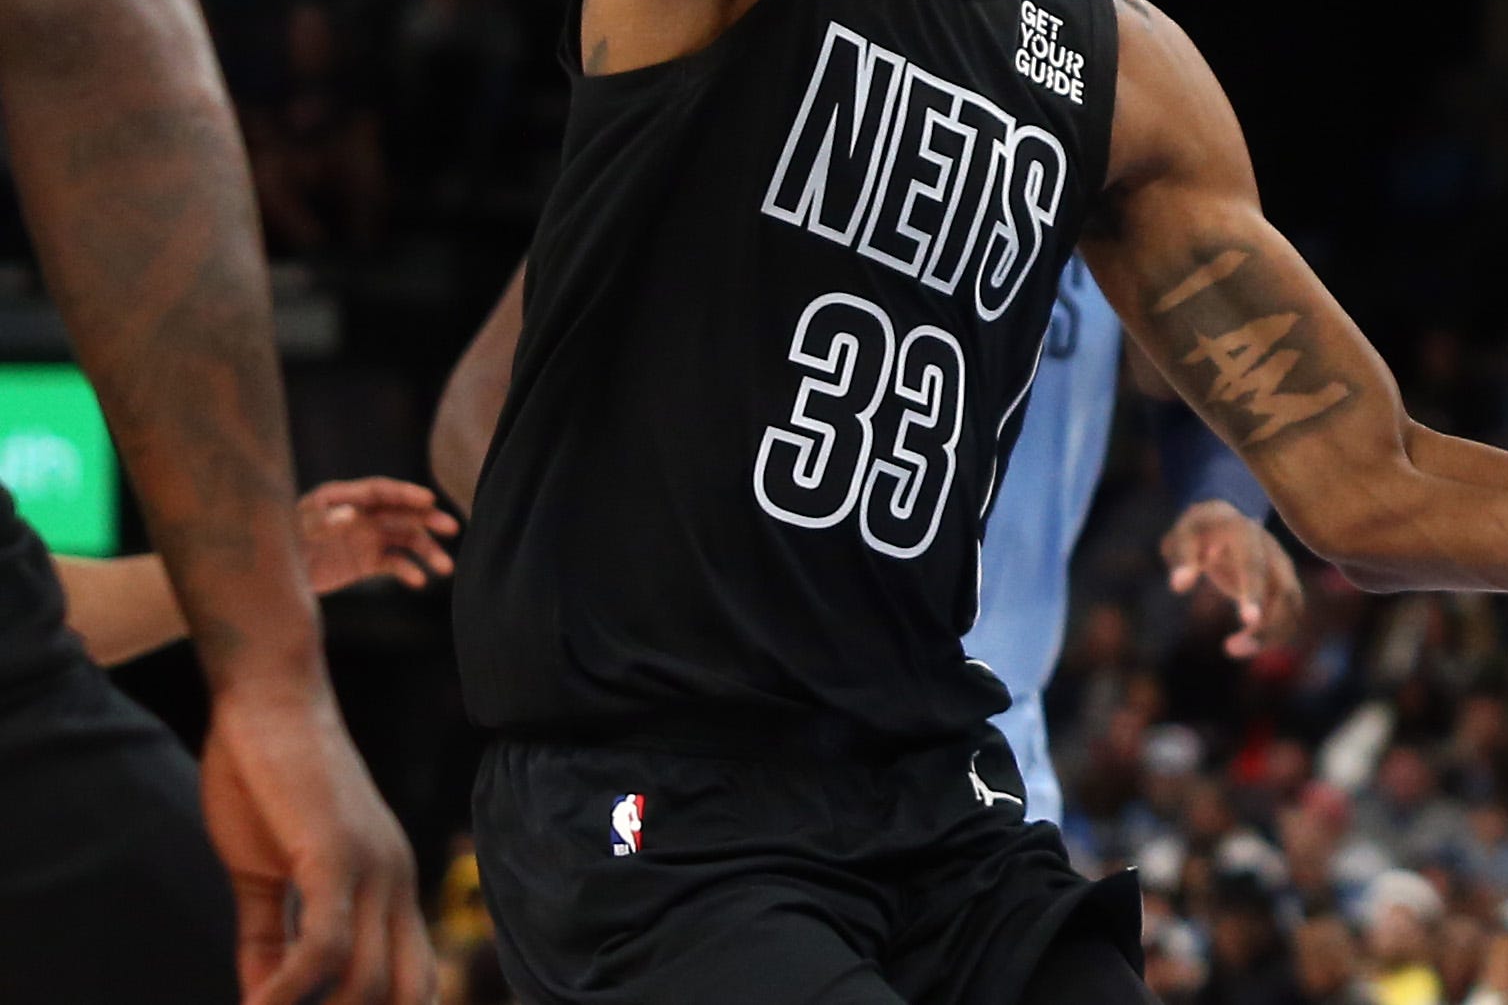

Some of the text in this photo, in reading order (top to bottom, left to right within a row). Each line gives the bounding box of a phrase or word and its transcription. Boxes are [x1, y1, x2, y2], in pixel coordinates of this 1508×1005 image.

[1021, 0, 1064, 41] GET
[1015, 48, 1085, 105] GUIDE
[1021, 22, 1085, 79] YOUR
[761, 21, 1066, 322] NETS
[753, 292, 966, 559] 33
